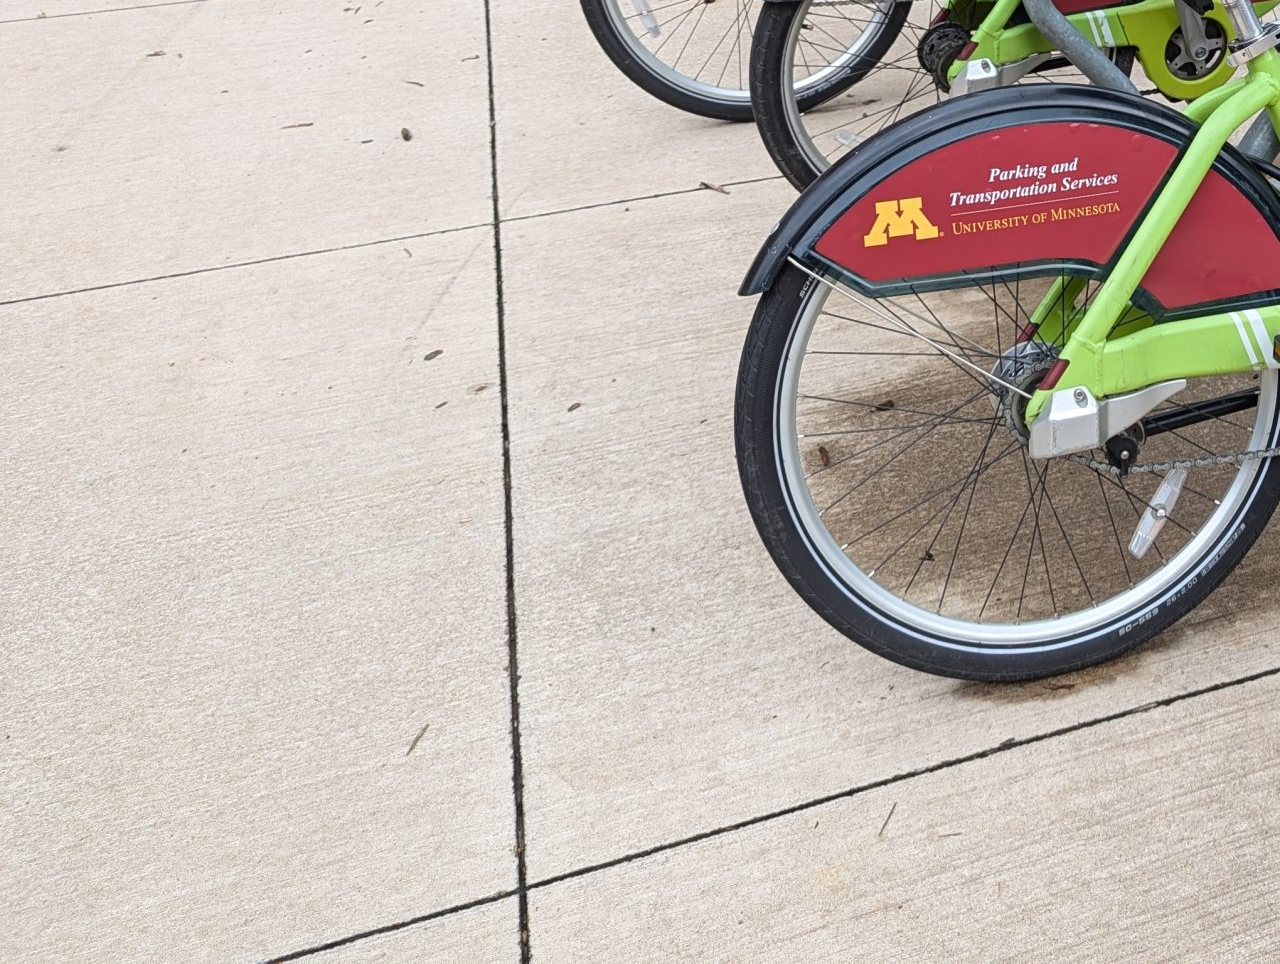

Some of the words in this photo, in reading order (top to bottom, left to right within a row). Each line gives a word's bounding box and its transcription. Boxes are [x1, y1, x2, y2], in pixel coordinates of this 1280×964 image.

[988, 164, 1047, 183] Parking
[1051, 157, 1079, 174] and
[950, 182, 1057, 207] Transportation
[1061, 173, 1118, 192] Services
[952, 214, 1029, 235] UNIVERSITY
[1050, 202, 1121, 222] MINNESOTA
